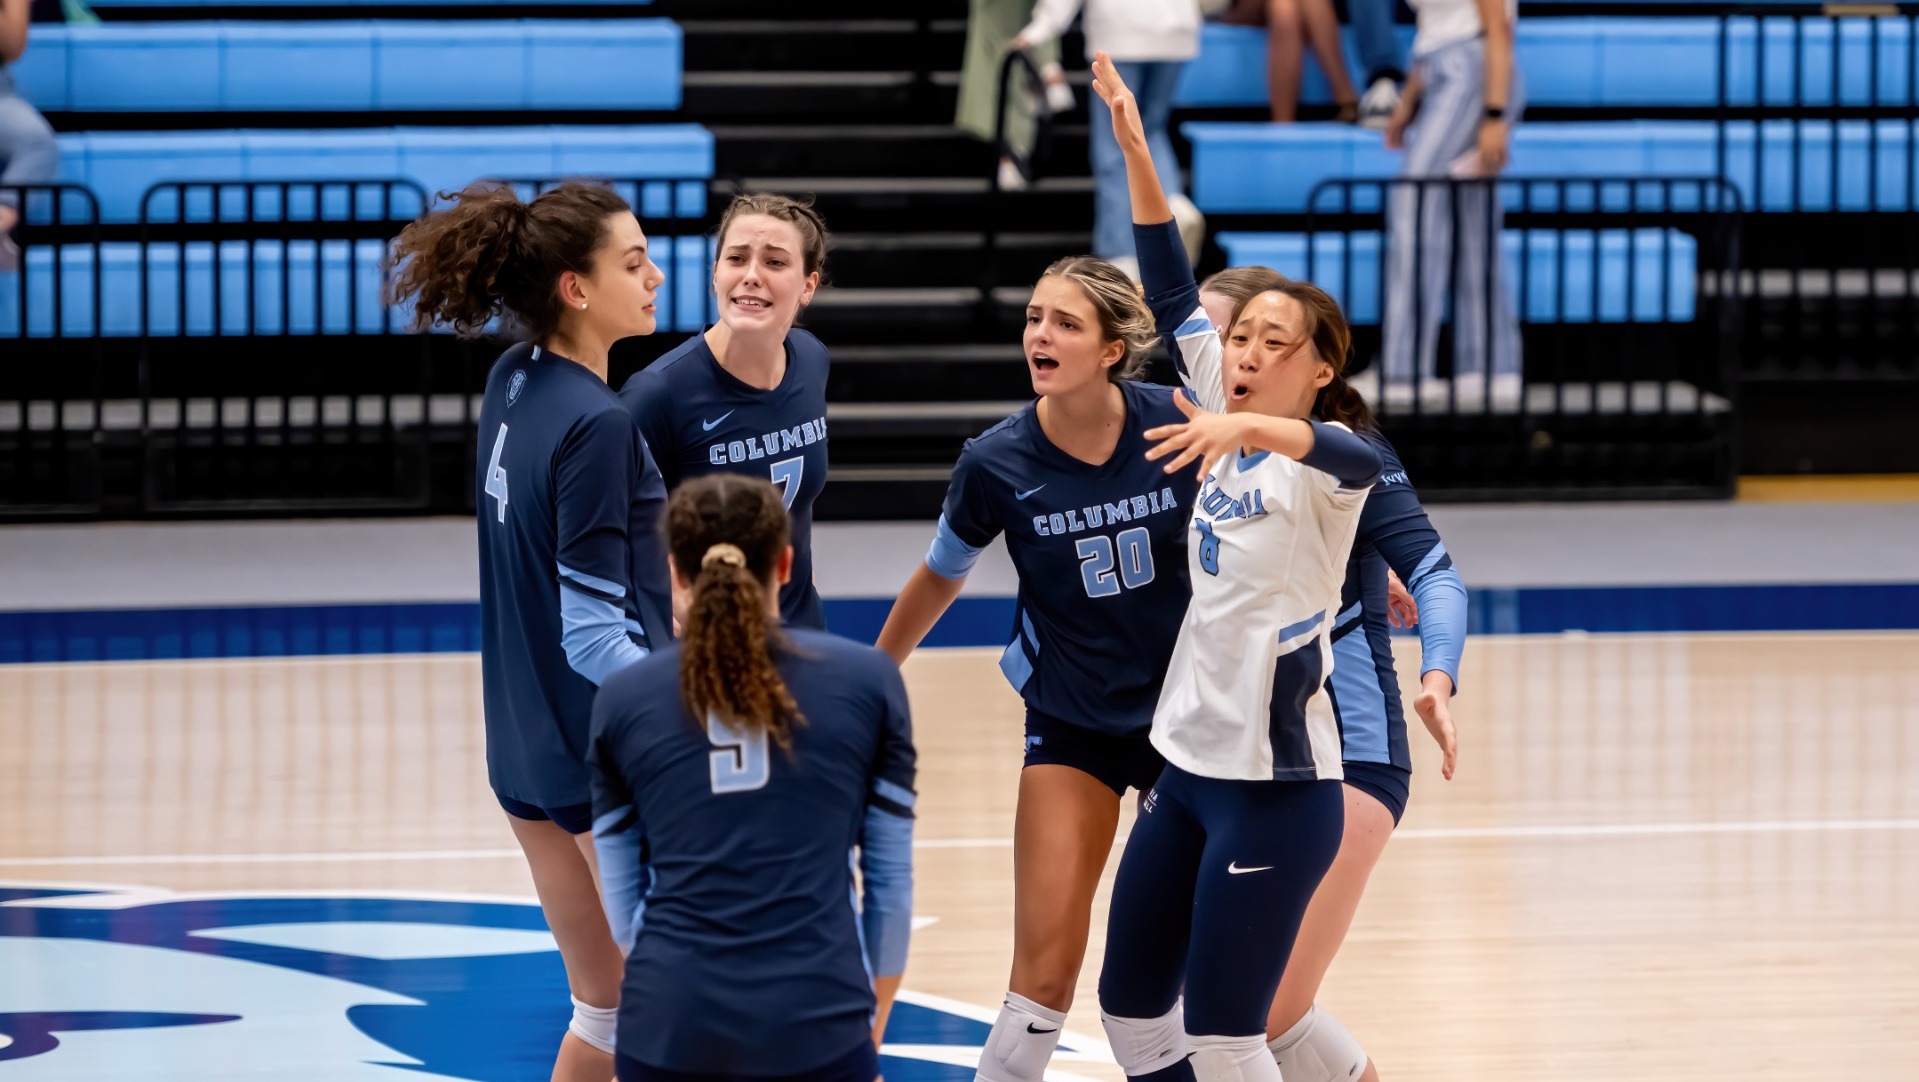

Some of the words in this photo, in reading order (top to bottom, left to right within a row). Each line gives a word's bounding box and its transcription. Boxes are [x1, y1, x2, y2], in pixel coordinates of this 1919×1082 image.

[485, 422, 508, 525] 4
[770, 455, 804, 513] 7
[1033, 487, 1177, 536] COLUMBIA
[1075, 526, 1156, 598] 20
